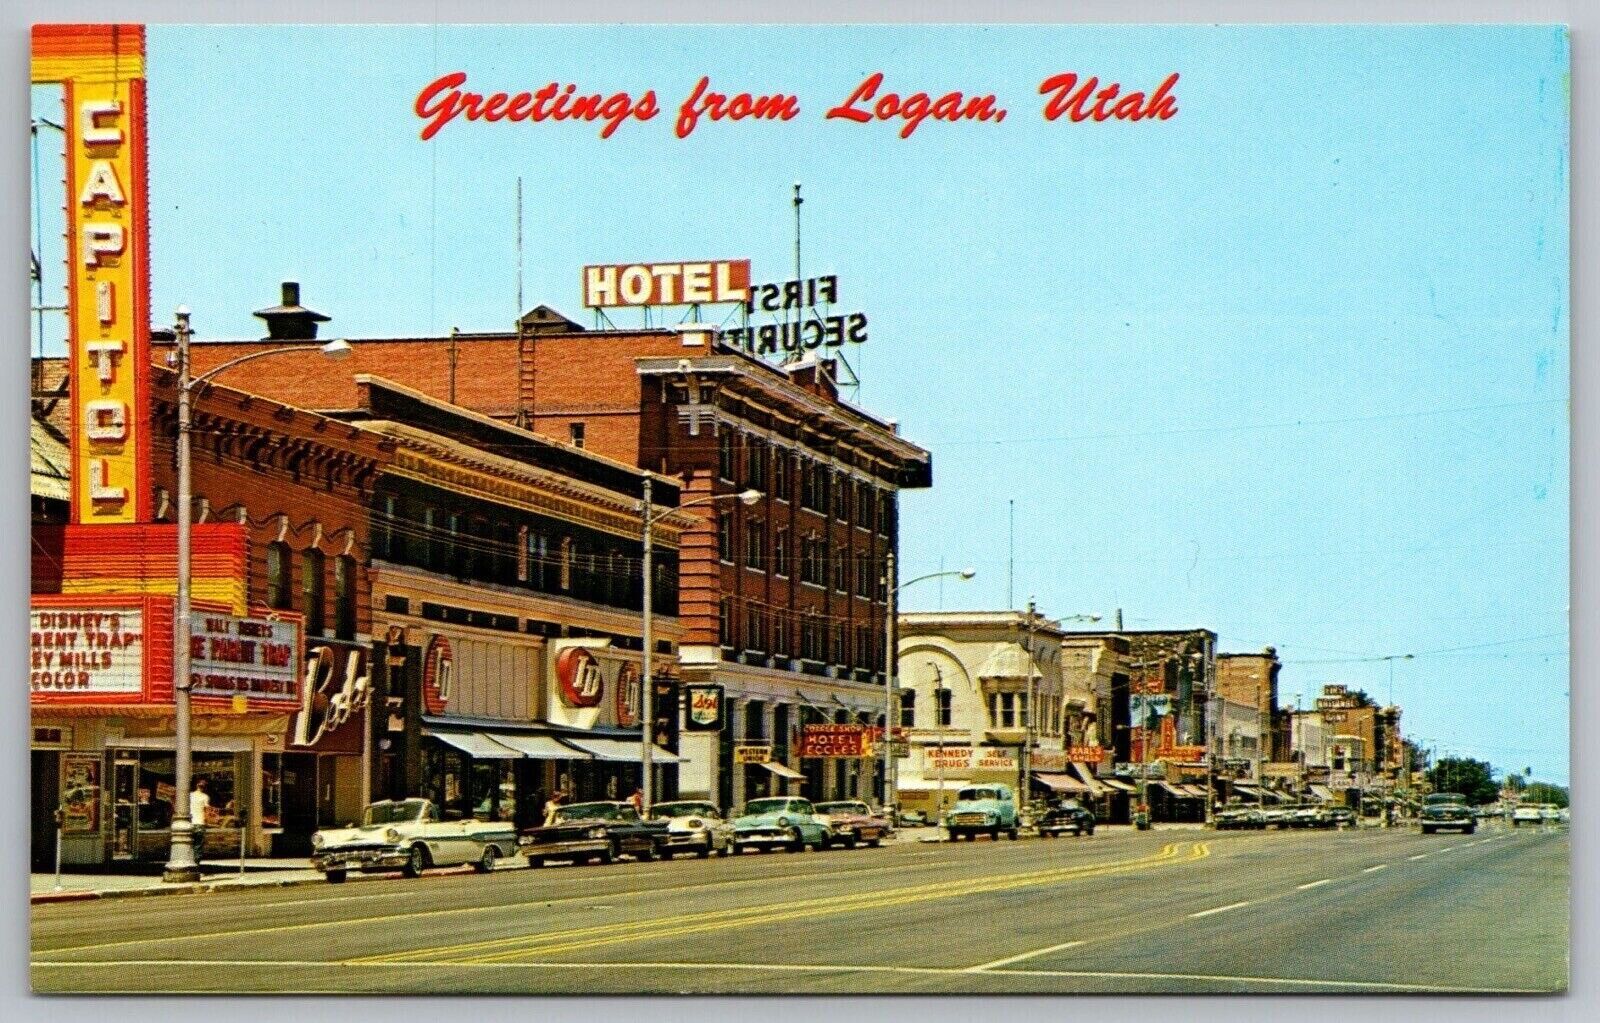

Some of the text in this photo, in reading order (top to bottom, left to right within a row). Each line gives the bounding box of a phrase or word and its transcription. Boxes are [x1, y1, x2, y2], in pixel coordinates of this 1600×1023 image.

[587, 262, 747, 307] HOTEL
[81, 99, 129, 503] CAPITOL
[40, 613, 120, 631] DISNEY'S
[59, 651, 112, 670] MILLS
[31, 671, 90, 690] COLOR
[808, 735, 856, 744] HOTEL
[806, 745, 858, 755] ECCLES
[927, 750, 974, 760] KENNEDY
[987, 749, 1008, 759] SELF
[935, 759, 970, 769] DRUGS
[979, 759, 1014, 767] SERVICE
